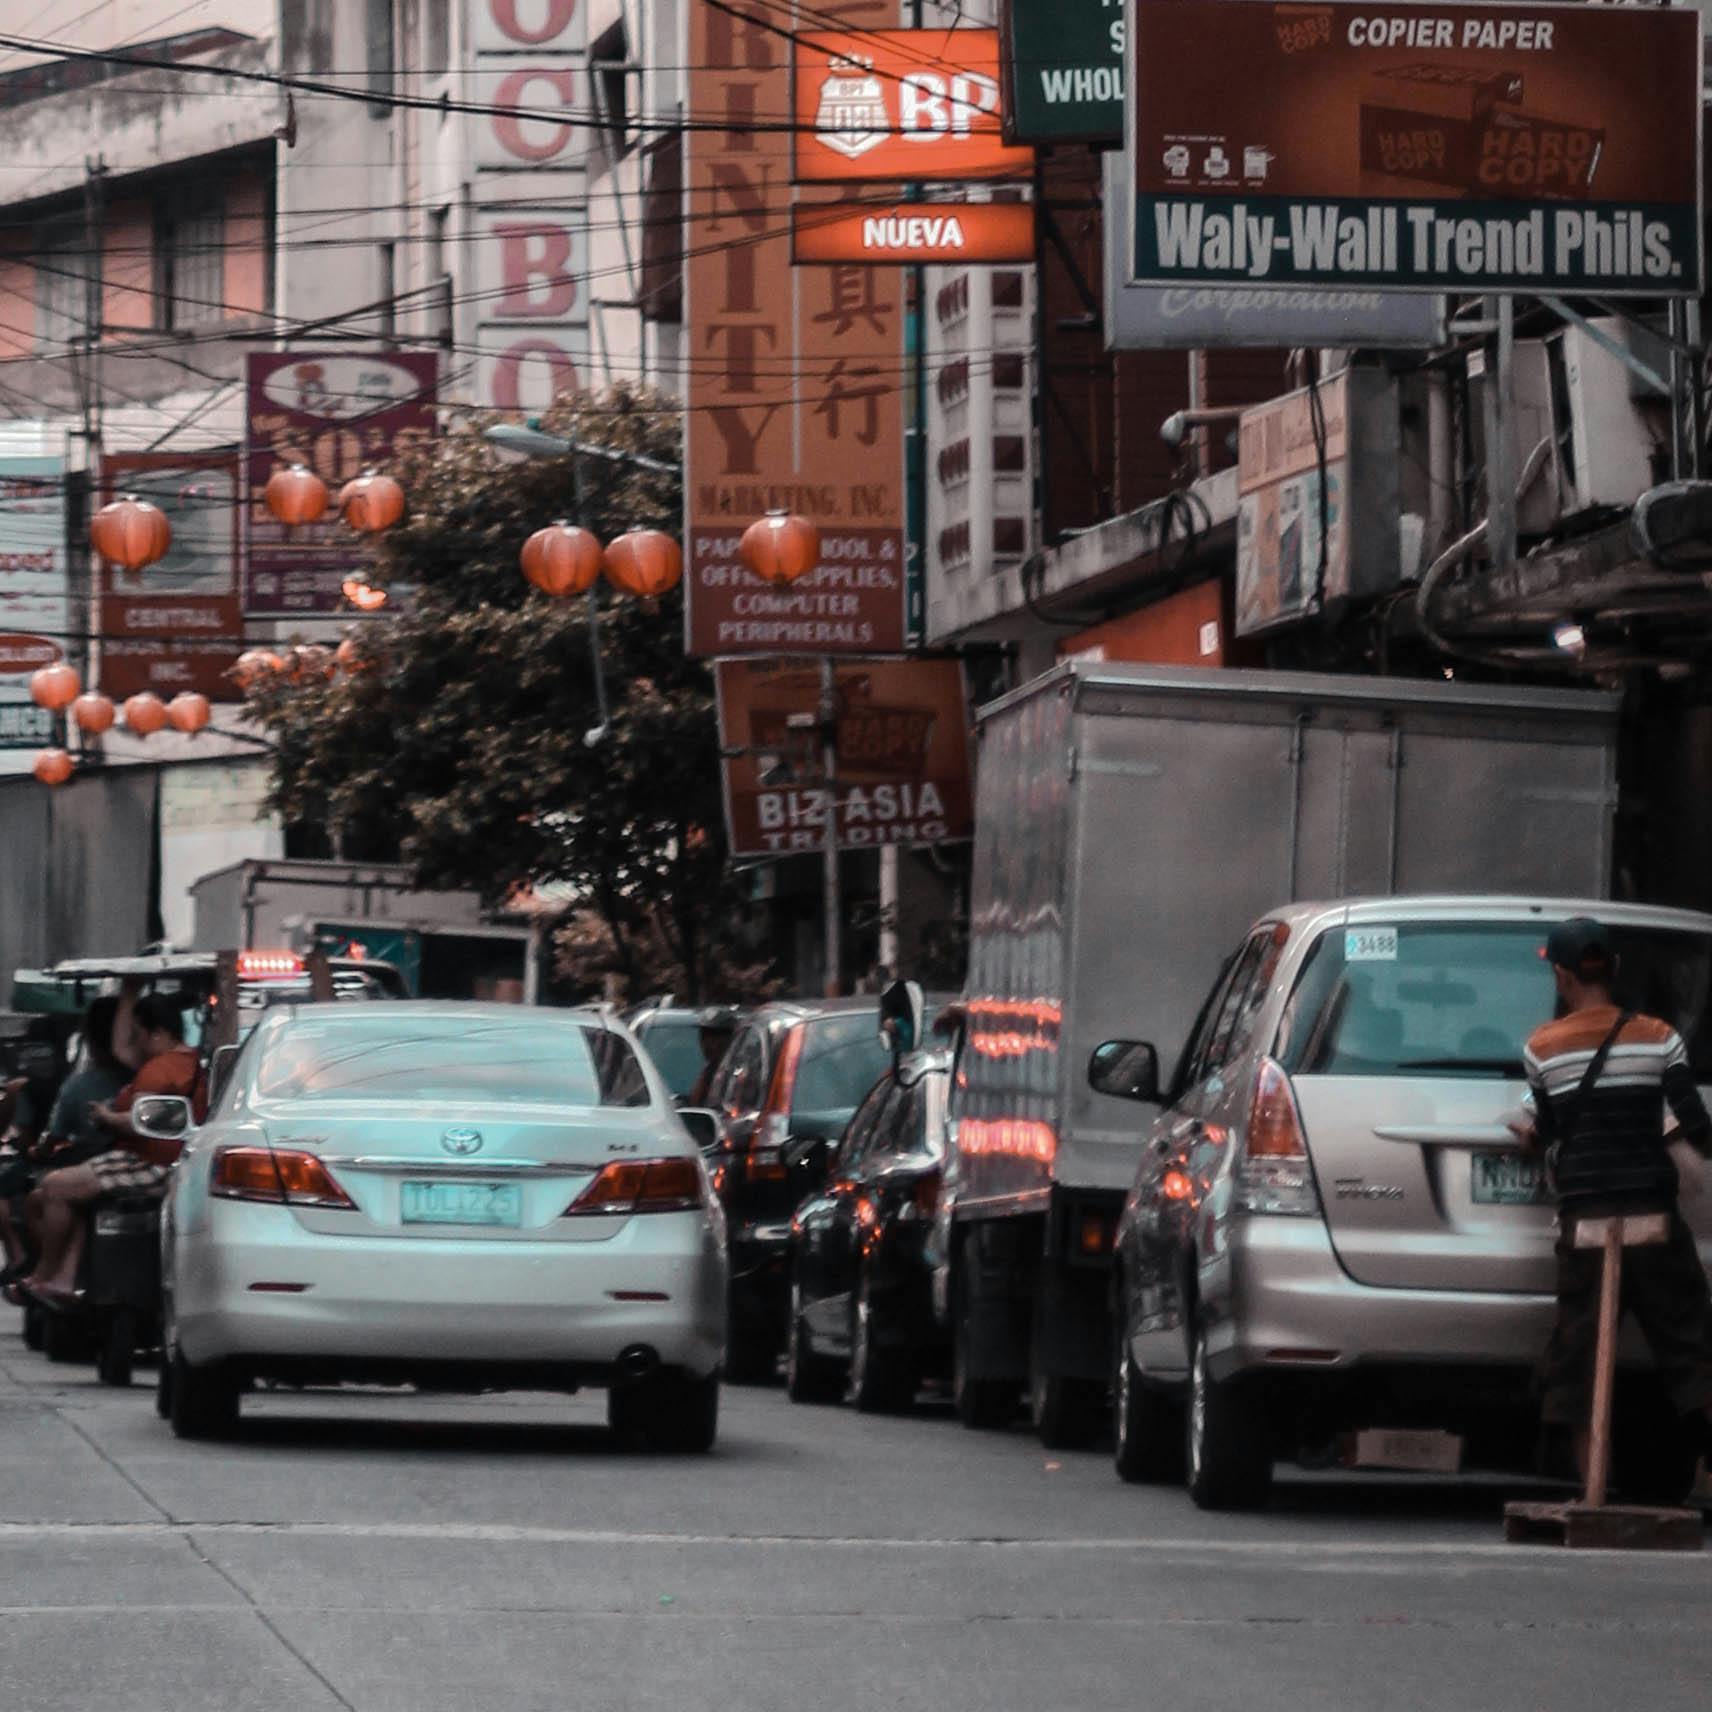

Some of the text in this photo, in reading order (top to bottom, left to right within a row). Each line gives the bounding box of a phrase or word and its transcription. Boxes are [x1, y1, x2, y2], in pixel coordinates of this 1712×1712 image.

[1348, 17, 1555, 51] COPIER PAPER
[1483, 128, 1590, 160] HARD
[1479, 156, 1587, 185] COPY
[863, 216, 965, 249] NUEVA
[1154, 202, 1683, 276] Waly-Wall Trend Phils.
[733, 593, 860, 616] COMPUTER
[719, 620, 875, 644] PERIPHERALS
[757, 781, 945, 829] BIZ ASIA
